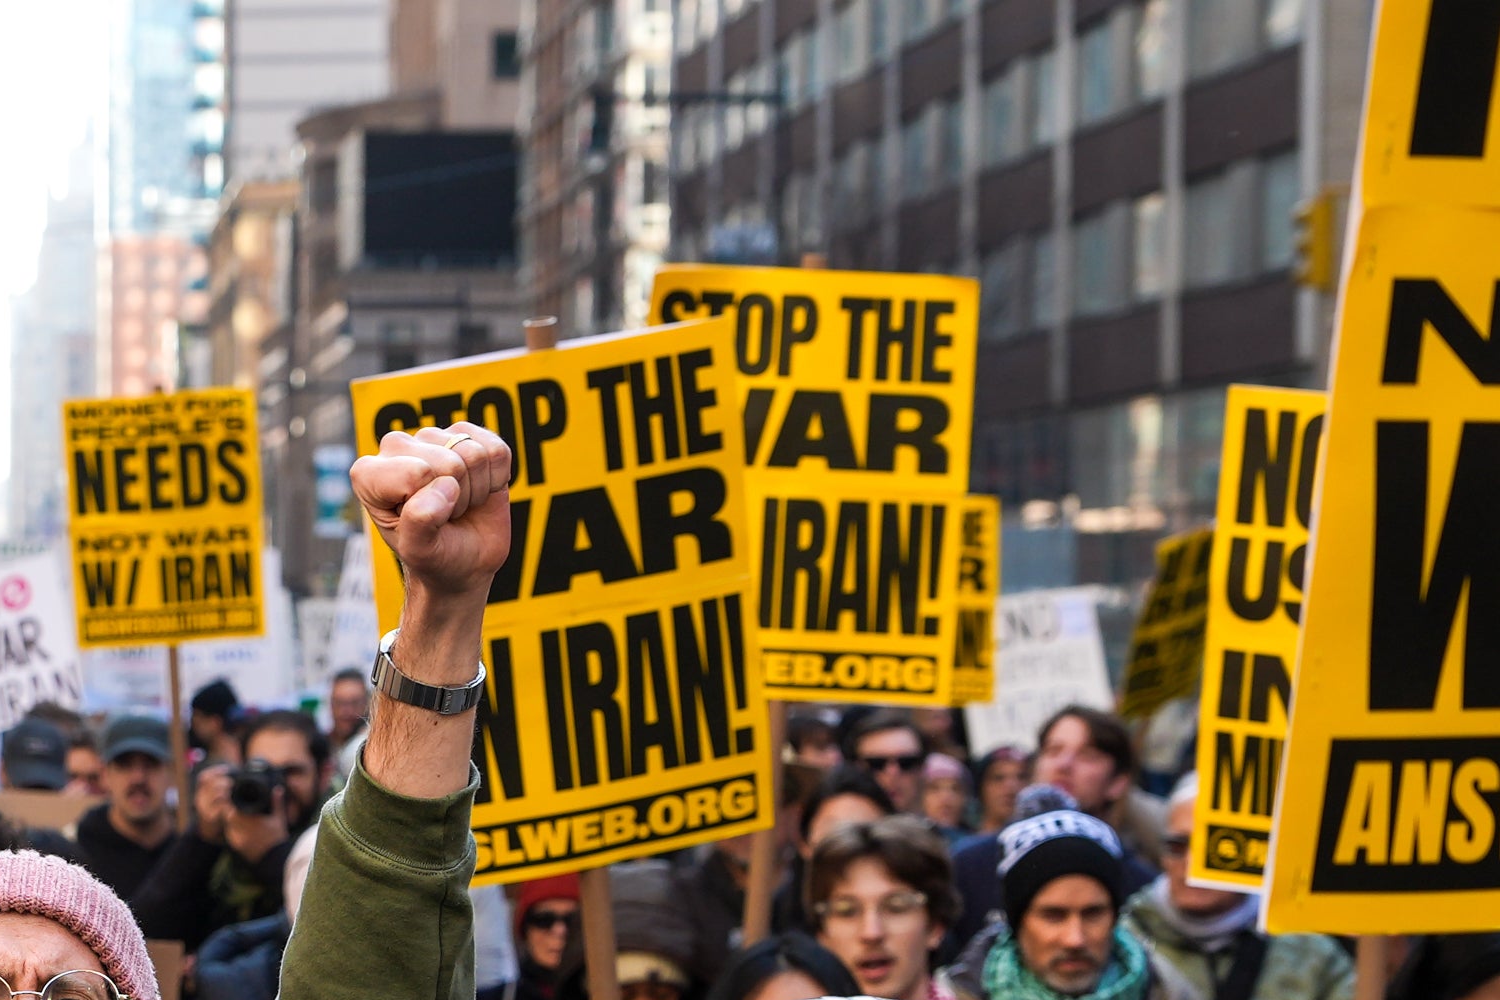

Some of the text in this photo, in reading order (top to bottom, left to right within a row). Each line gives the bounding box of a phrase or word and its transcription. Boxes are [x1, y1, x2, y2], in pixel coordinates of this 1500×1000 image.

[840, 297, 953, 384] THE
[587, 347, 722, 472] THE
[74, 440, 248, 515] NEEDS
[79, 526, 248, 552] NOT WAR
[81, 551, 252, 608] W/ IRAN
[760, 498, 944, 636] IRAN!
[472, 638, 525, 803] N
[540, 594, 754, 789] IRAN!
[766, 652, 936, 692] EB.ORG
[475, 779, 756, 870] SLWEB.ORG
[1333, 758, 1500, 865] ANS
